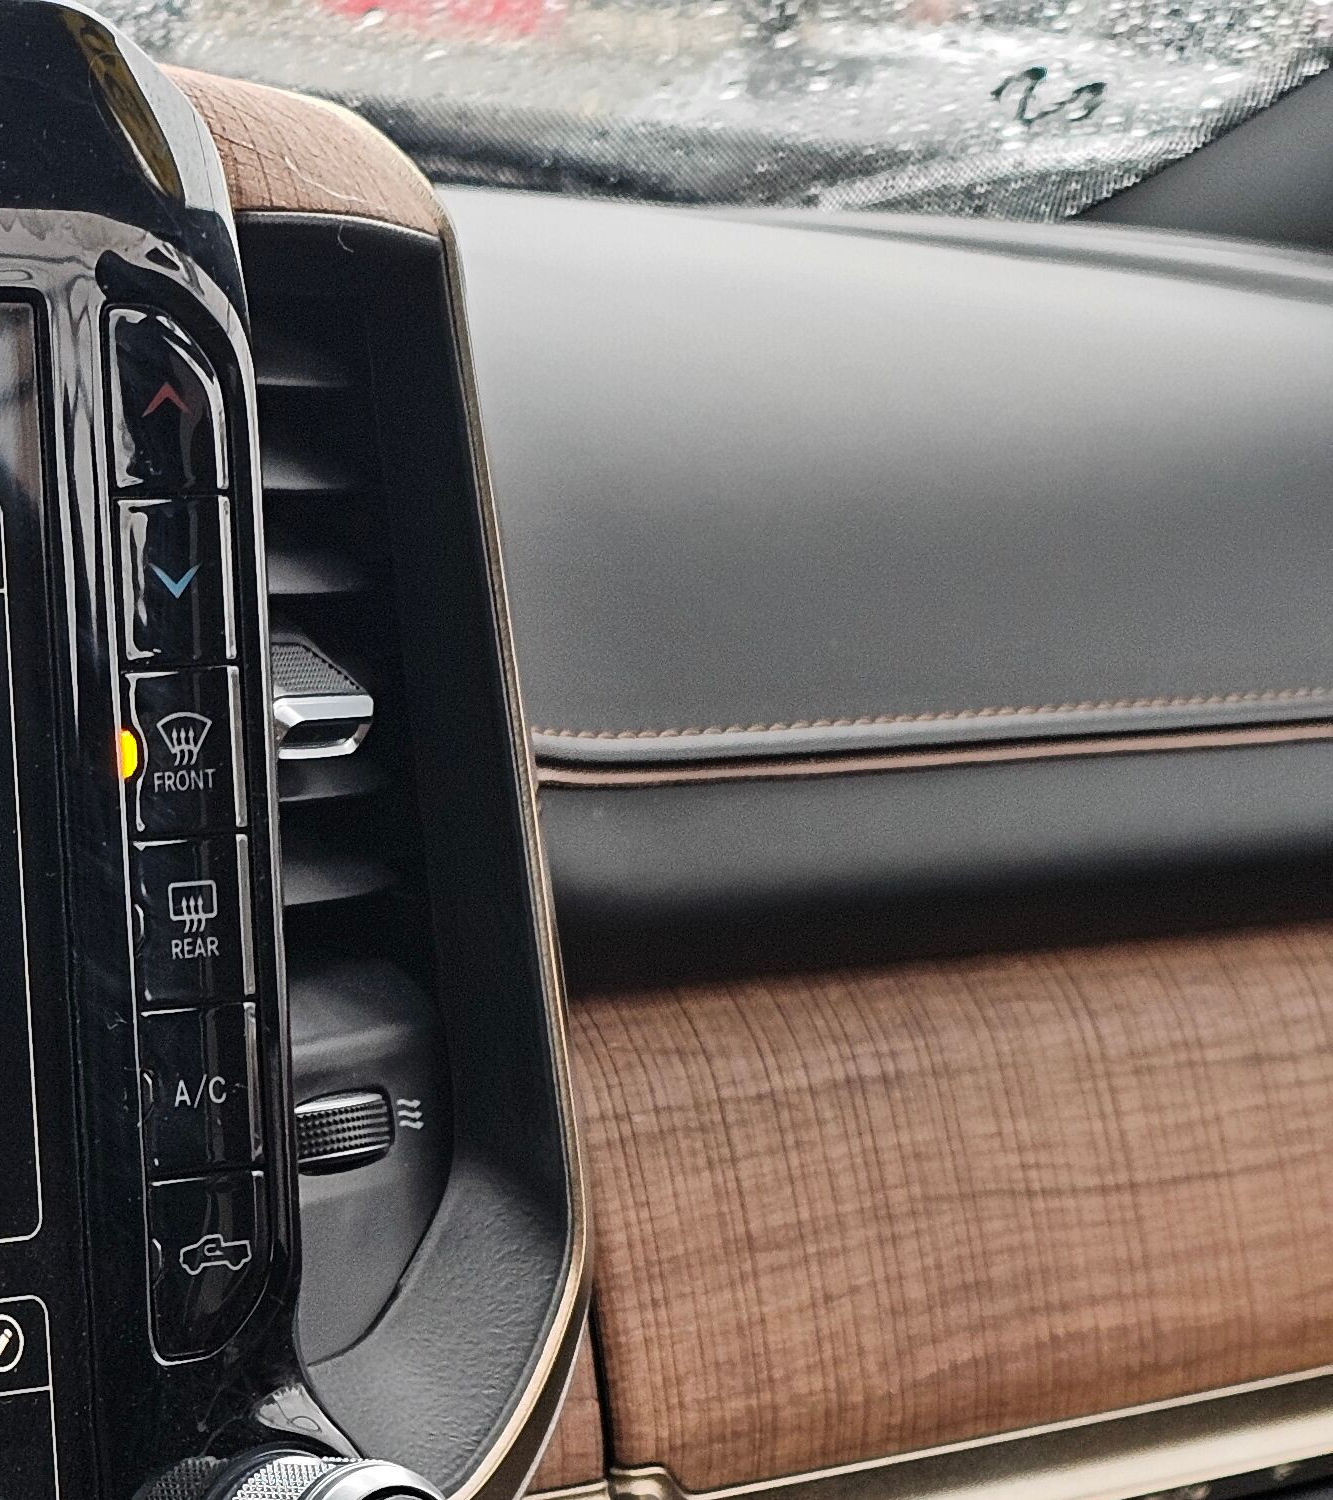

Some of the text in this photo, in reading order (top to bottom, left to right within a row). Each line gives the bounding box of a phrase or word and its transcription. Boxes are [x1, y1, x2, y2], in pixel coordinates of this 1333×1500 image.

[153, 768, 216, 793] FRONT
[171, 936, 220, 960] REAR
[174, 1074, 227, 1109] A/C
